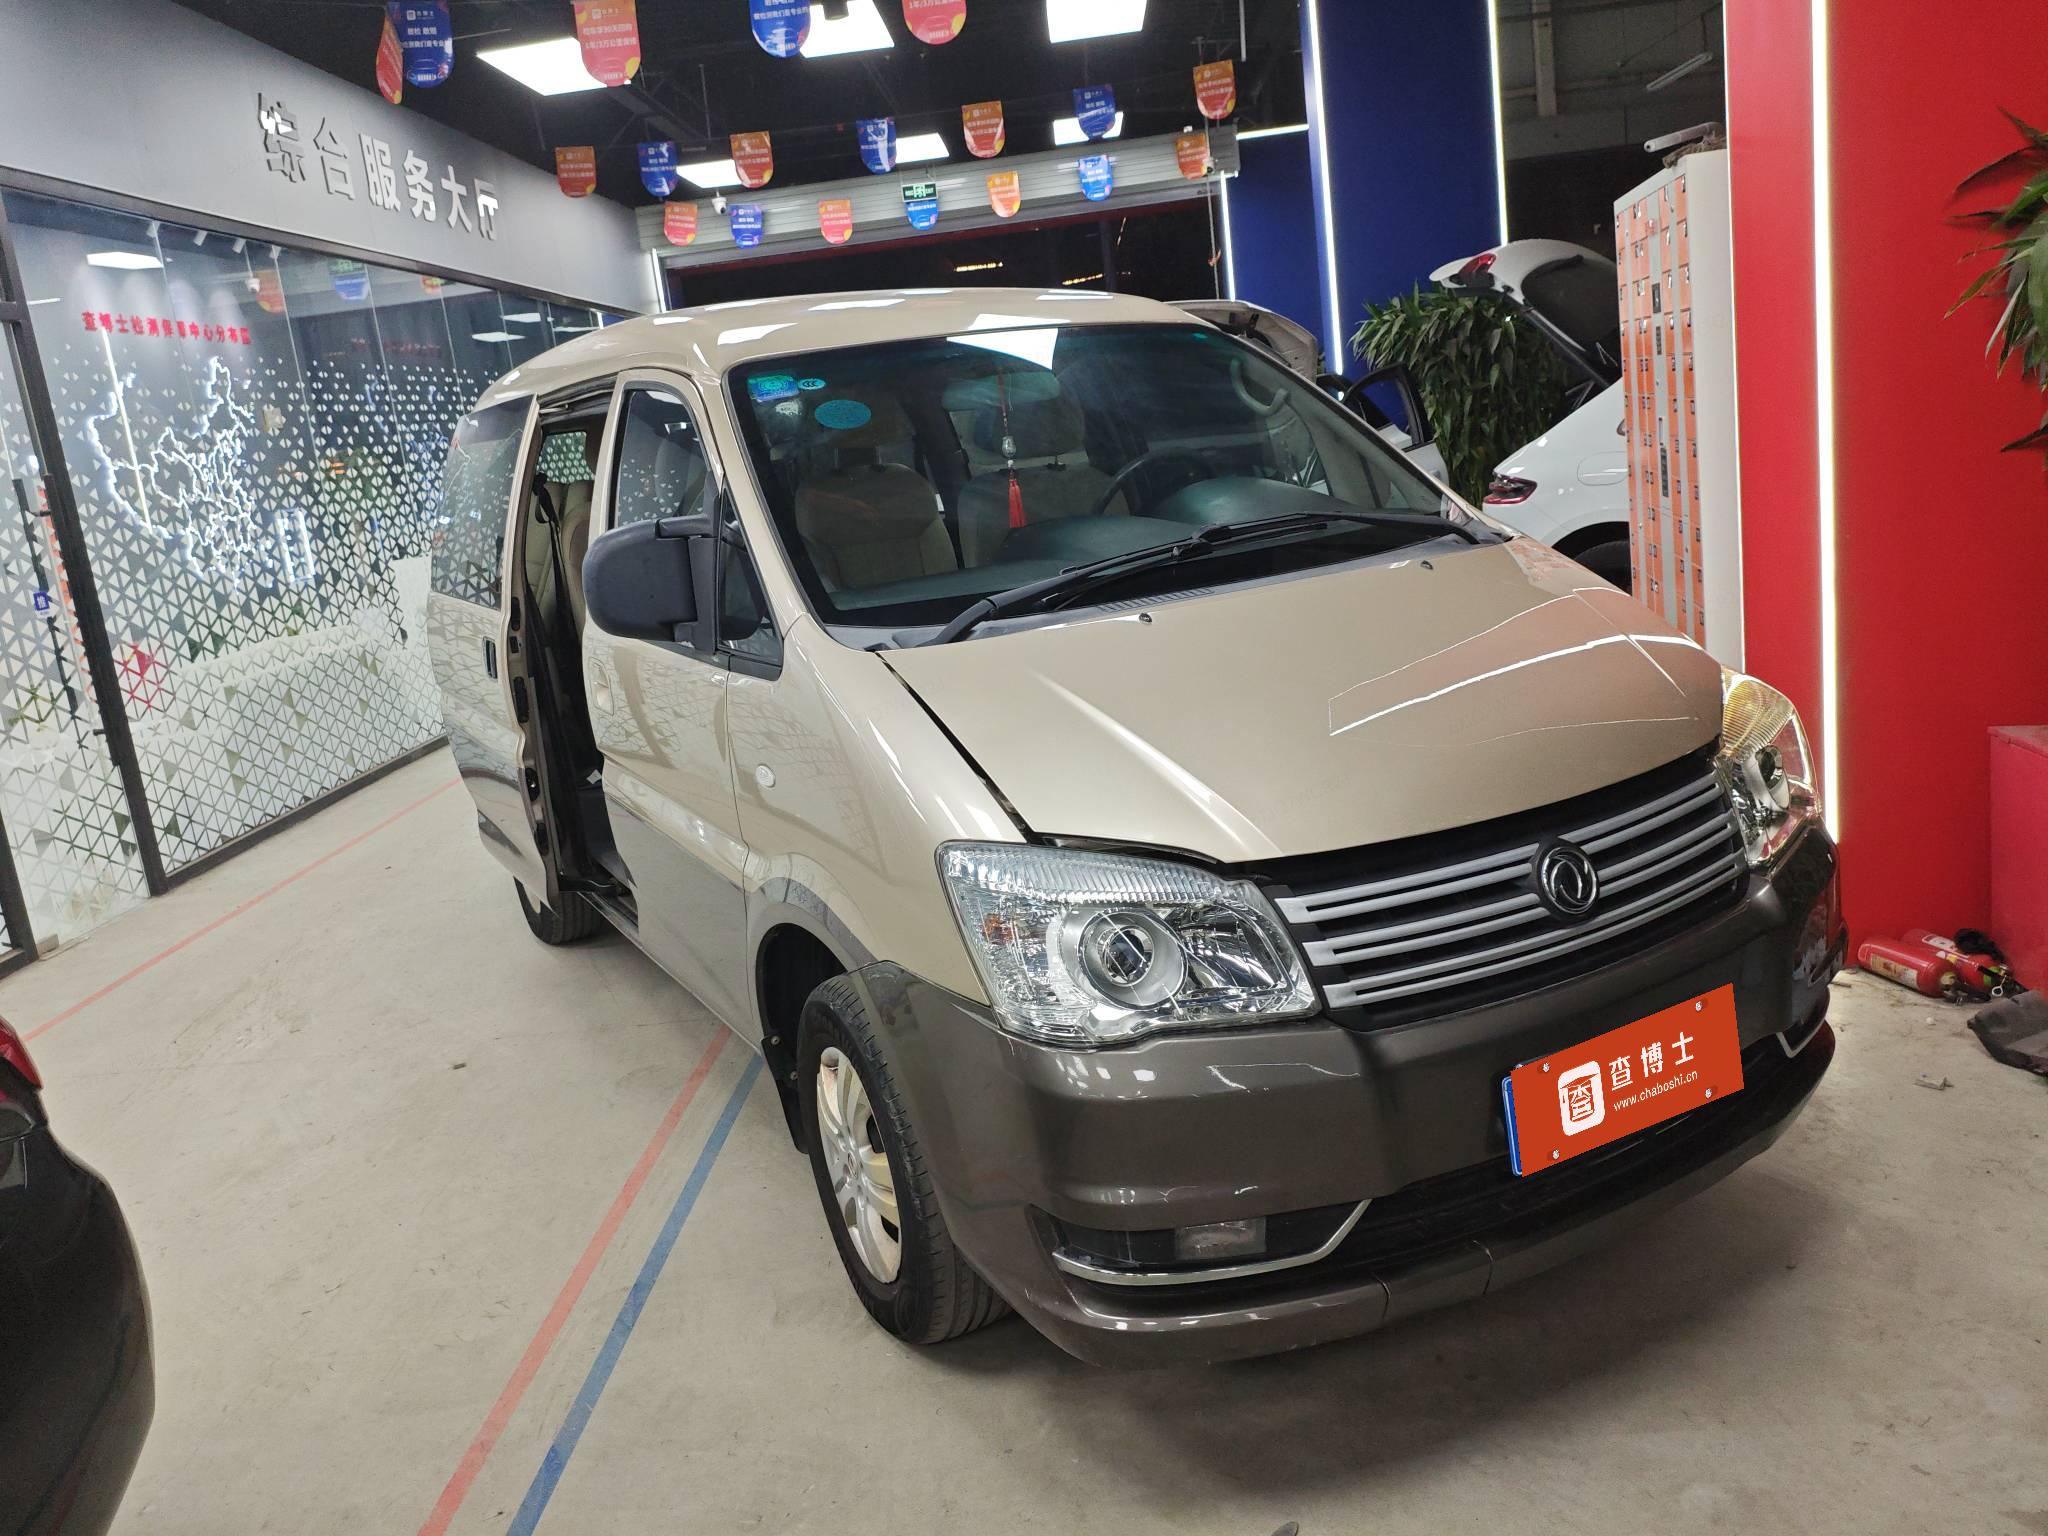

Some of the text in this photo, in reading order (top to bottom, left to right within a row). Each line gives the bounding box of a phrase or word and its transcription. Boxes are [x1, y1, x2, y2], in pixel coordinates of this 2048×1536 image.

[257, 92, 500, 241] 综合服务大厅
